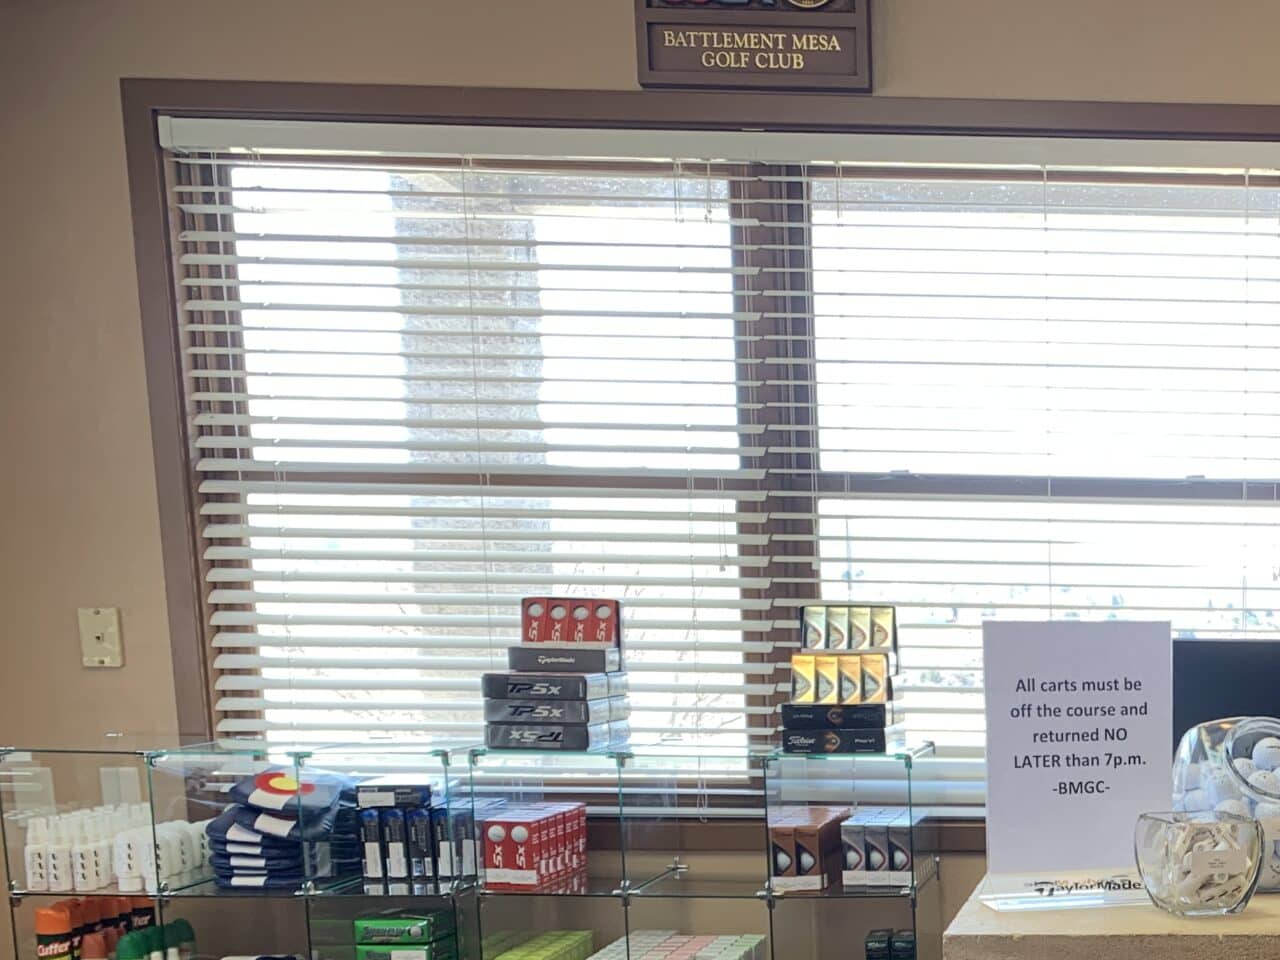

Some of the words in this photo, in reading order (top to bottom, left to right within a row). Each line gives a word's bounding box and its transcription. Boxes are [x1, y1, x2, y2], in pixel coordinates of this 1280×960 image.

[664, 31, 786, 49] BATTLEMENT
[792, 34, 841, 51] MESA
[702, 52, 750, 68] GOLF
[755, 53, 805, 69] CLUB
[1016, 678, 1036, 692] All
[1040, 678, 1077, 692] carts
[1081, 678, 1119, 692] must
[1123, 677, 1142, 691] be
[1010, 704, 1032, 718] off
[1037, 704, 1061, 717] the
[1066, 705, 1116, 717] course
[1120, 702, 1148, 716] and
[1033, 729, 1099, 743] returned
[1104, 728, 1128, 741] NO
[1014, 755, 1061, 768] LATER
[1065, 754, 1099, 767] than
[1104, 752, 1147, 769] 7p.m.
[1052, 780, 1111, 795] -BMGC-
[1034, 877, 1142, 896] TaylorMade
